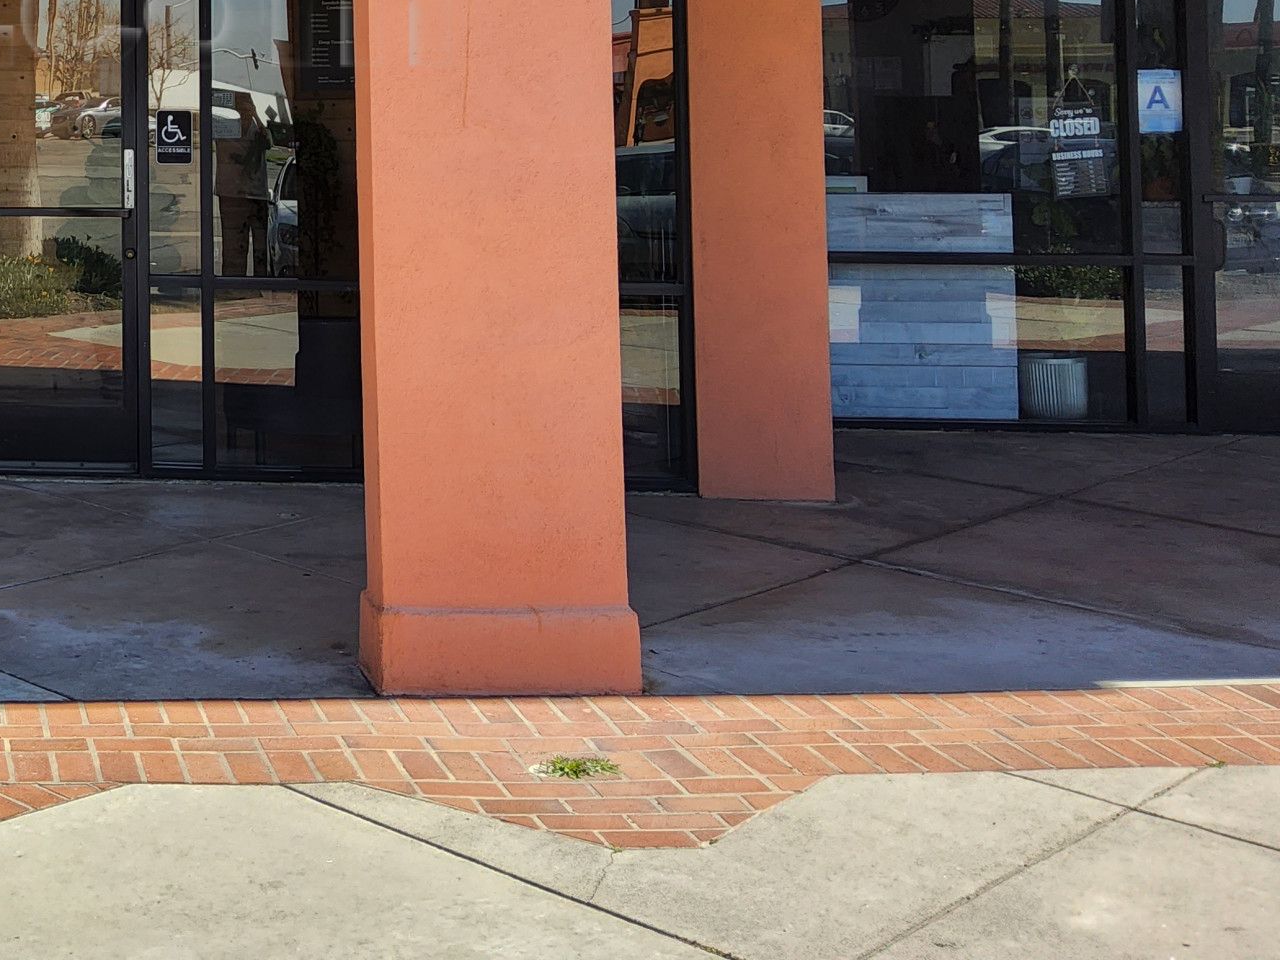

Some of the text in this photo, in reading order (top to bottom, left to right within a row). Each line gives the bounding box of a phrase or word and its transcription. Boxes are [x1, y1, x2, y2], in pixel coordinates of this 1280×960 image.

[1146, 85, 1170, 110] A
[1053, 107, 1074, 117] Sorry
[1049, 116, 1101, 138] CLOSED
[1051, 148, 1104, 161] BUSINESS HOURS
